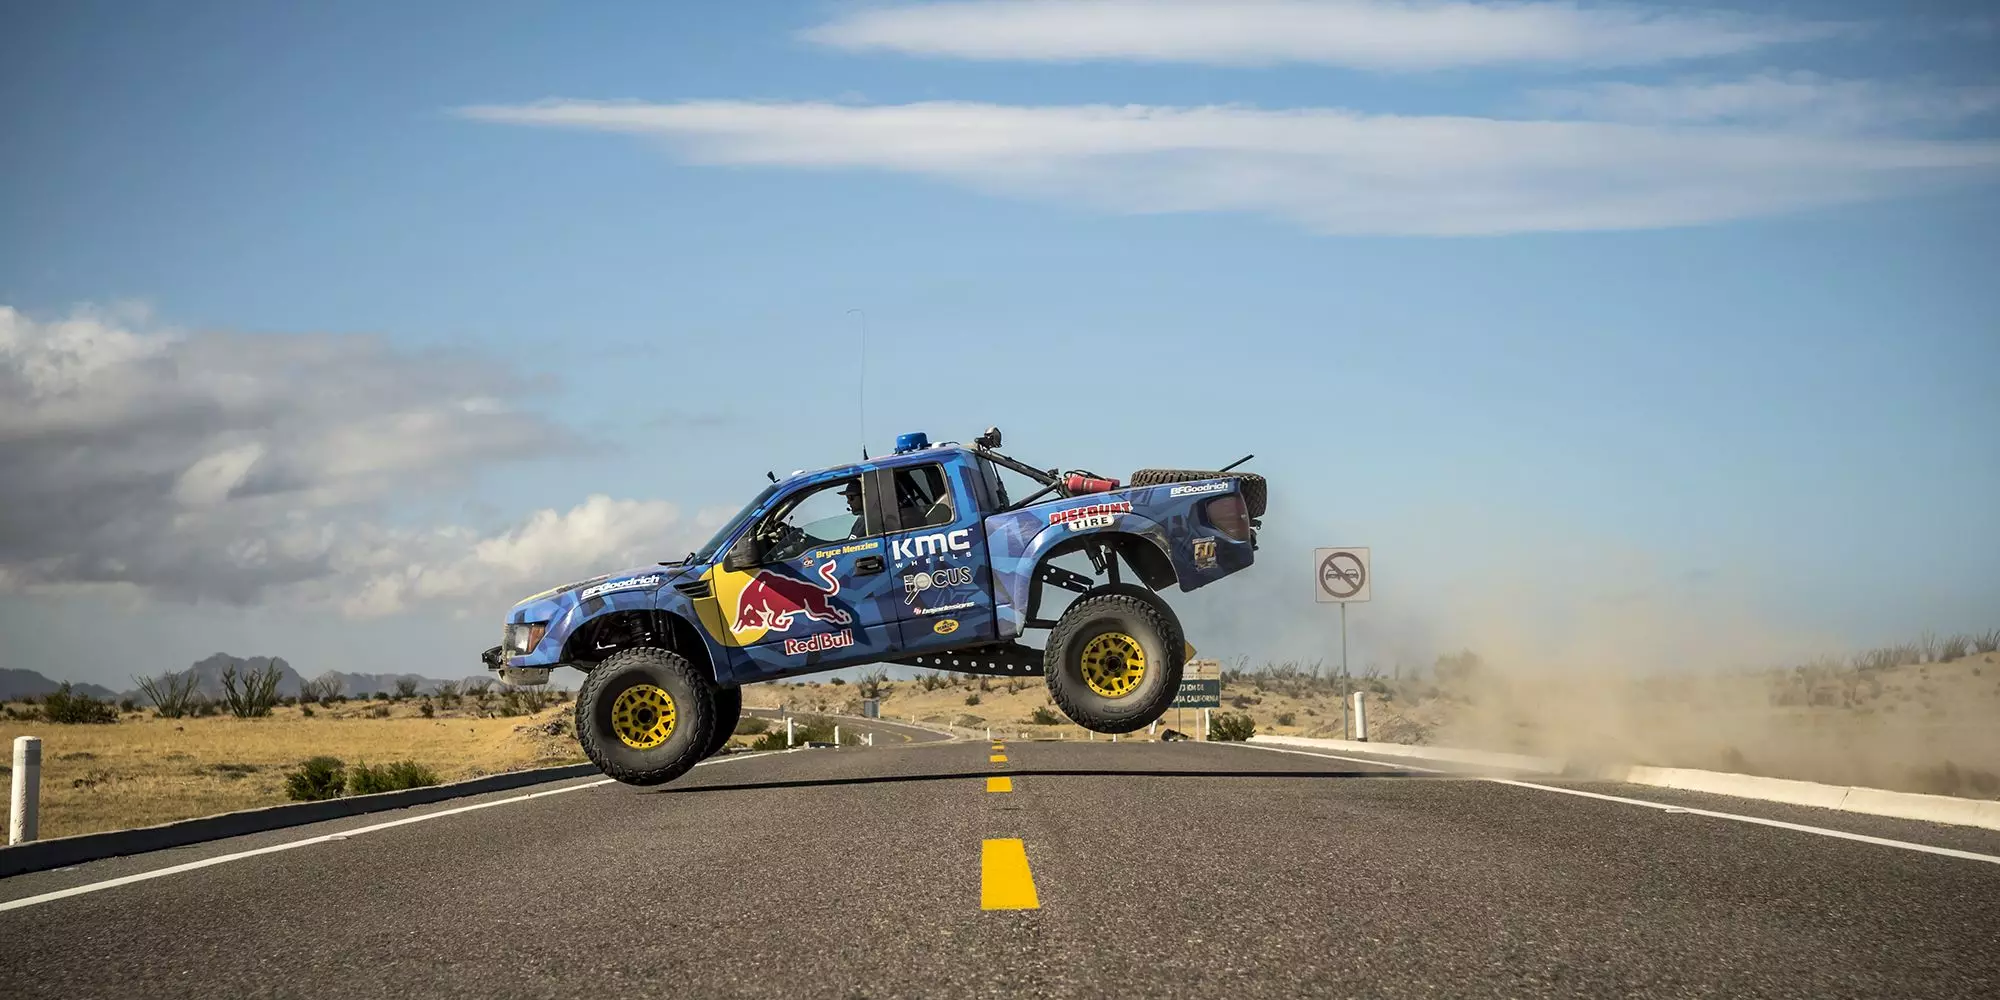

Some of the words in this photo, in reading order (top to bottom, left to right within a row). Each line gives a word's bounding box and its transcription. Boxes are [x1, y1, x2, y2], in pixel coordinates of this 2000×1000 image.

[1171, 482, 1228, 495] BFGoodrich
[1049, 502, 1130, 525] DISCOUNT
[1073, 517, 1109, 529] TIRE
[816, 548, 841, 559] Bryce
[842, 542, 878, 554] Menzies
[895, 551, 972, 568] WHEELS
[582, 575, 660, 599] BFGoodrich
[784, 633, 819, 655] Red
[819, 628, 854, 650] Bull
